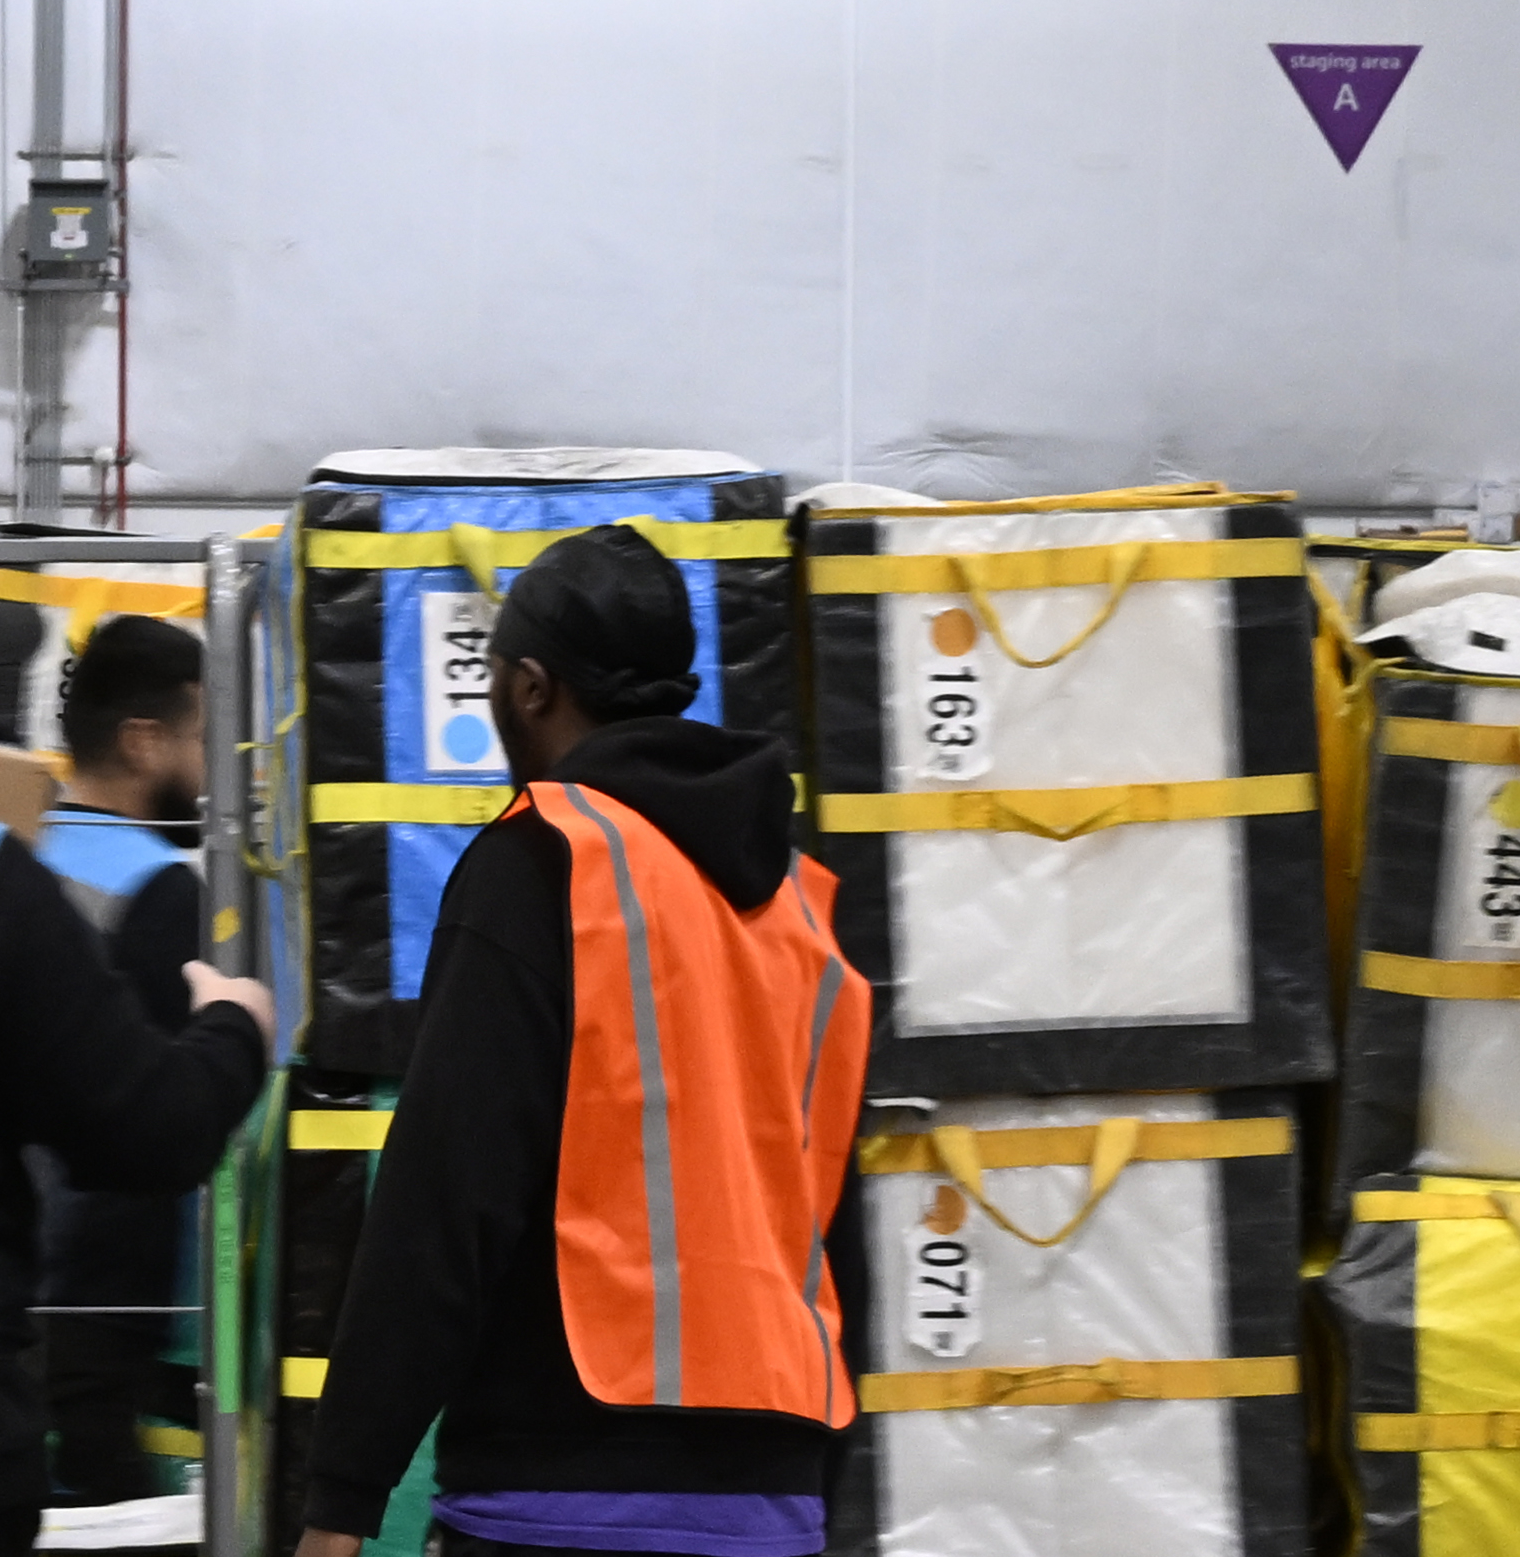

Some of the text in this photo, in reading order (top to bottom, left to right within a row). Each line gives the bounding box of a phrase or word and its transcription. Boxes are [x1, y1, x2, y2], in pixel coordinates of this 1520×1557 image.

[1290, 52, 1402, 72] staging area
[1332, 83, 1360, 112] A
[443, 626, 492, 709] 134
[927, 664, 980, 747] 163
[1479, 833, 1520, 917] 443
[918, 1240, 972, 1319] 071
